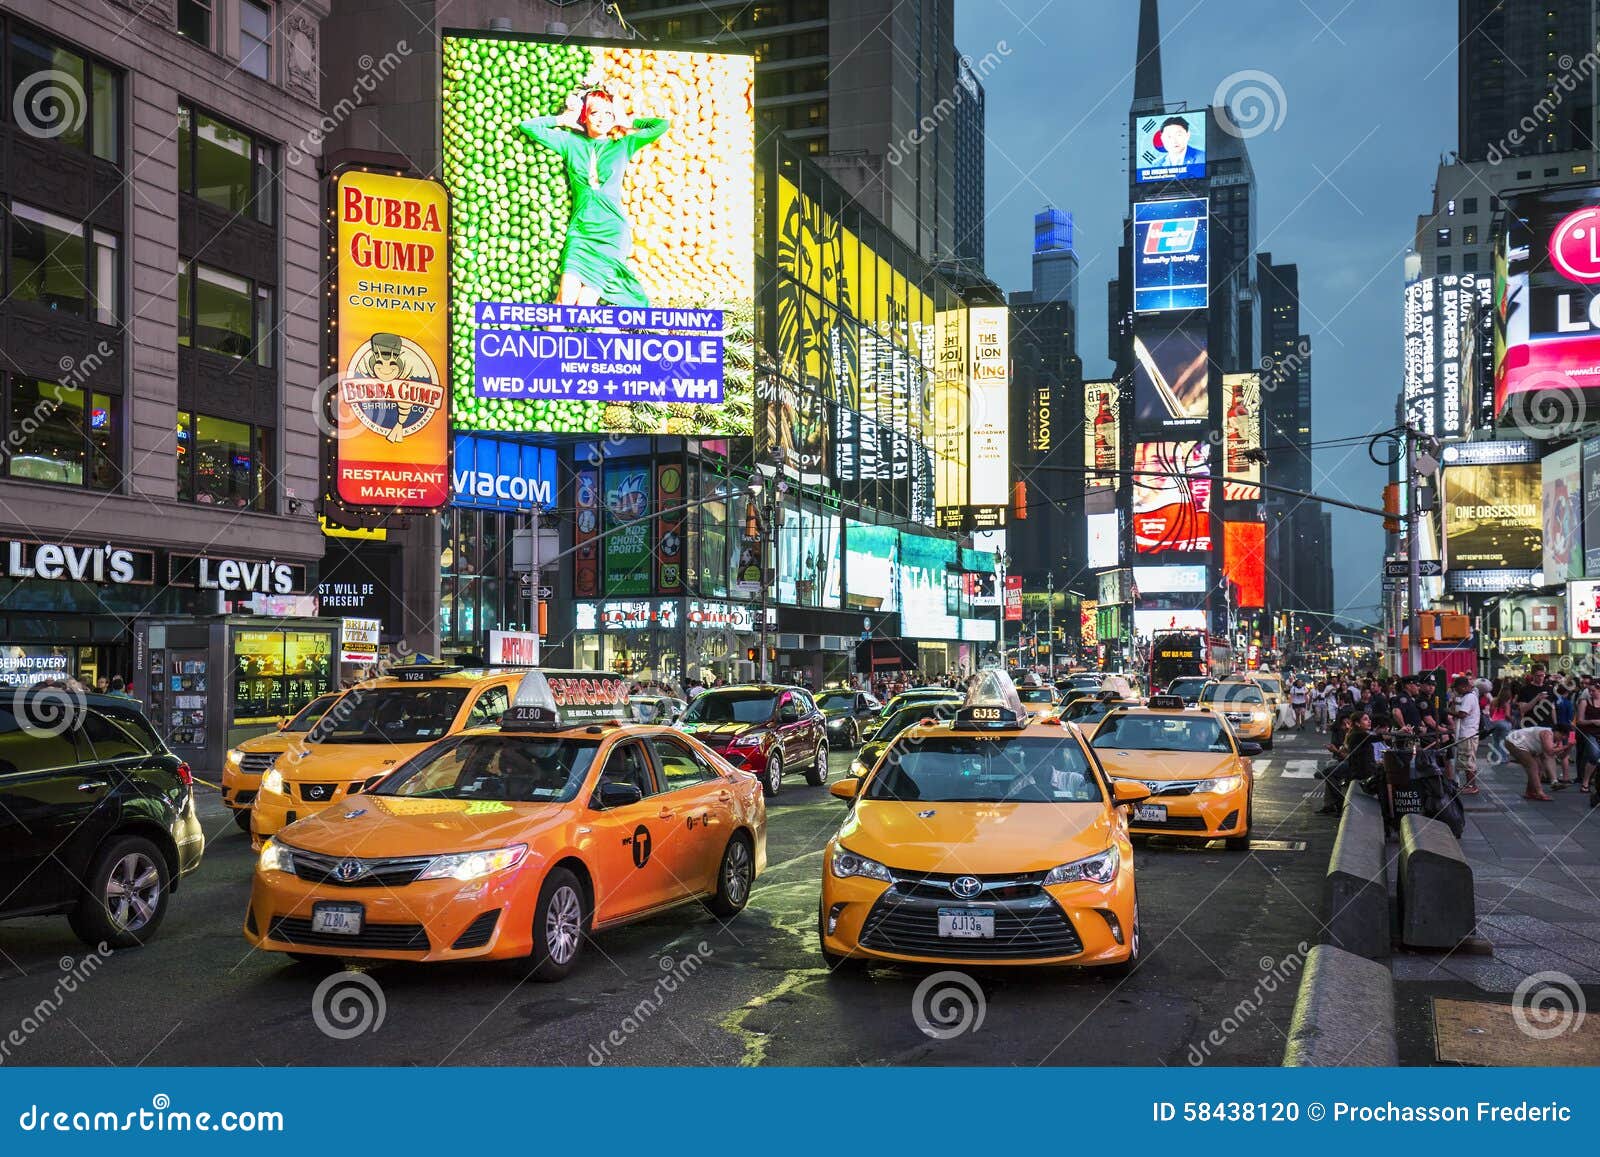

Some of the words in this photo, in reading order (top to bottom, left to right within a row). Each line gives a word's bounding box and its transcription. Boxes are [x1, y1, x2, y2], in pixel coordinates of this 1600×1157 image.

[344, 186, 441, 232] BUBBA
[351, 233, 434, 273] GUMP
[358, 281, 428, 296] SHRIMP
[349, 295, 437, 313] COMPANY
[482, 306, 495, 321] A
[500, 306, 562, 323] FRESH
[566, 308, 613, 325] TAKE
[618, 310, 646, 326] ON
[652, 311, 717, 328] FUNNY.
[1443, 290, 1458, 358] EXPRESS
[979, 334, 997, 342] THE
[976, 346, 1001, 361] LION
[1422, 316, 1434, 384] EXPRESS
[561, 362, 589, 373] NEW
[591, 363, 641, 374] SEASON
[974, 362, 1005, 380] KING
[347, 380, 395, 400] BUBBA
[399, 383, 441, 405] GUMP
[483, 376, 524, 392] WED
[528, 378, 573, 394] JULY
[577, 379, 598, 395] 29
[622, 380, 665, 397] 11PM
[1444, 362, 1459, 431] EXPRESS
[362, 402, 398, 411] SHRIMP
[1038, 387, 1050, 451] NOVOTEL
[1460, 448, 1505, 459] sunglass
[1507, 445, 1526, 456] hut
[342, 468, 445, 484] RESTAURANT
[360, 485, 427, 499] MARKET
[1456, 506, 1475, 519] ONE
[1476, 504, 1536, 518] OBSESSION
[608, 545, 642, 555] SPORTS
[335, 584, 358, 594] WILL
[362, 584, 374, 595] BE
[323, 596, 365, 607] PRESENT
[345, 620, 377, 631] BELLA
[345, 631, 368, 642] VITA
[36, 658, 66, 668] EVERY
[547, 677, 630, 706] CHICAGO
[517, 708, 540, 719] 2L80
[973, 709, 1000, 719] 6J13
[636, 833, 647, 863] T
